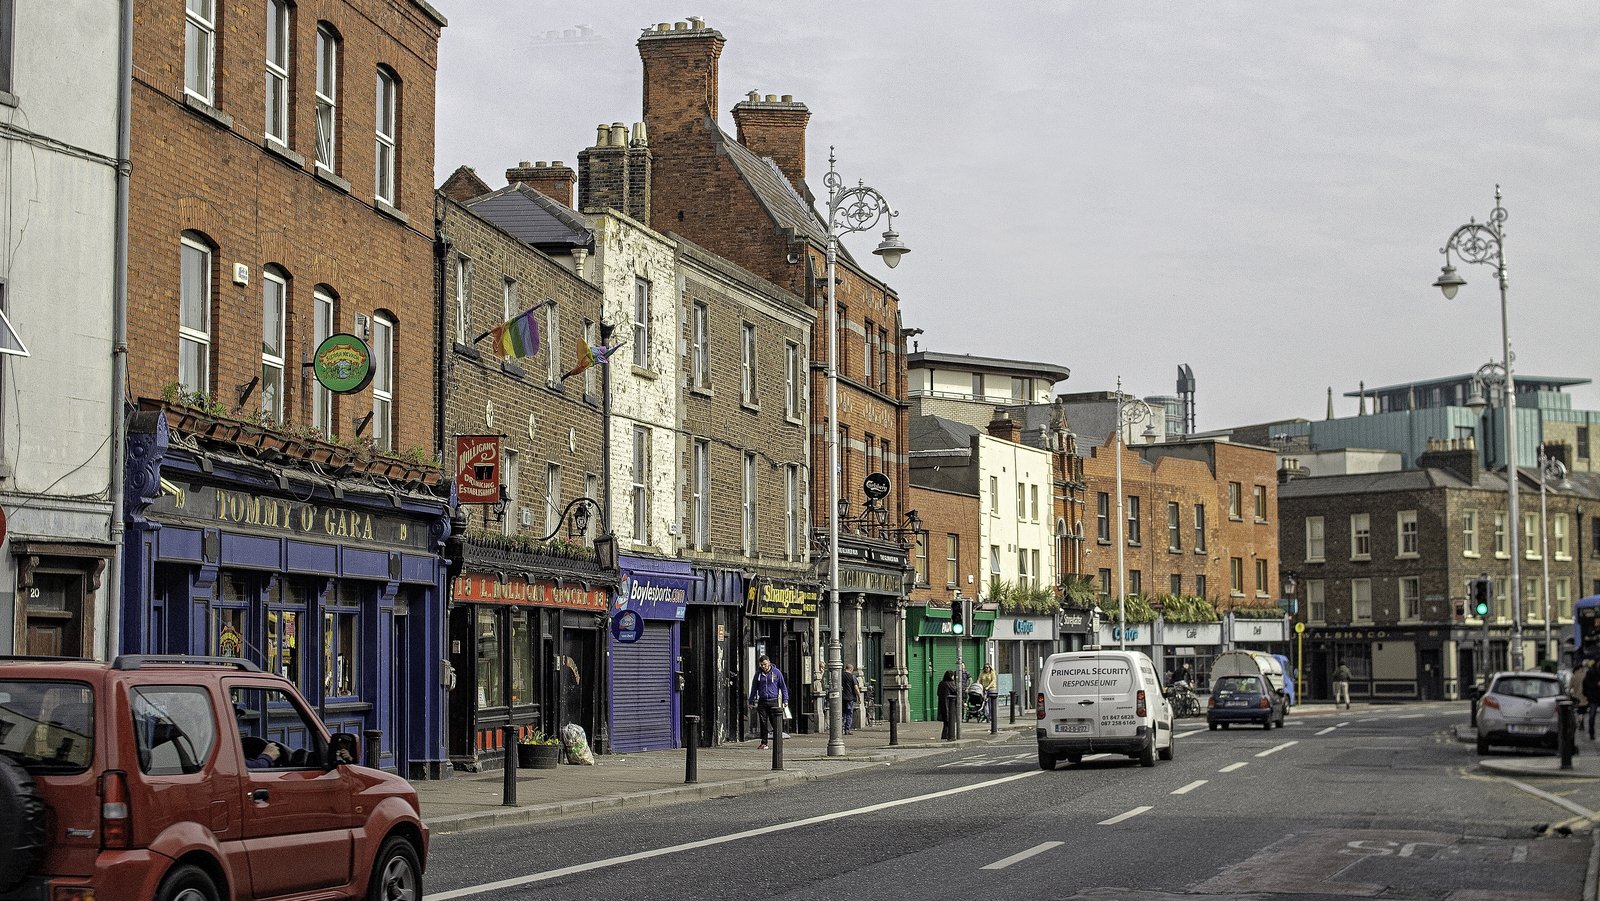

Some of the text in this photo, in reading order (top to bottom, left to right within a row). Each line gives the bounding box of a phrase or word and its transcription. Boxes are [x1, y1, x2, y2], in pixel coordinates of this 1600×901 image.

[464, 473, 495, 489] DRINKING
[216, 489, 292, 530] TOMMY
[400, 523, 408, 541] 19
[30, 588, 40, 598] 20
[1112, 626, 1139, 641] Cntra
[1186, 628, 1197, 639] Café
[1253, 625, 1262, 636] Deli
[1051, 667, 1130, 676] PRINCIPAL SECURITY
[1099, 679, 1117, 687] UNIT
